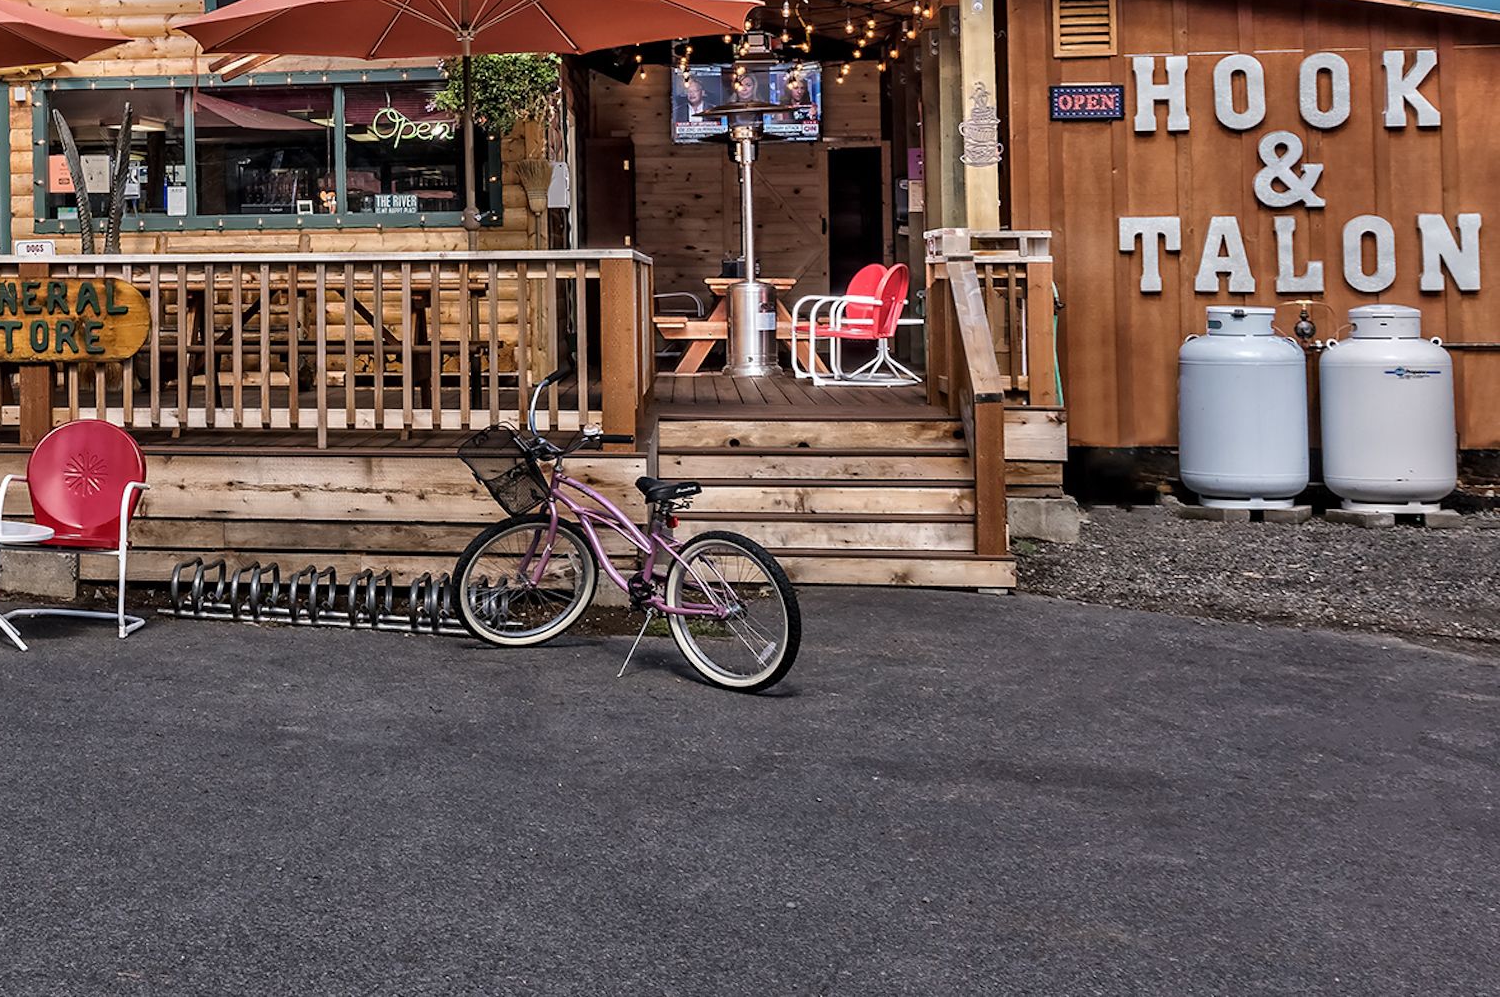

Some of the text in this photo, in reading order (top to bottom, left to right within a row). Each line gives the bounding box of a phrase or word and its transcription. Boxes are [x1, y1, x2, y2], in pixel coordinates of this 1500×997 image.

[1058, 93, 1116, 111] OPEN
[1131, 48, 1442, 133] HOOK
[373, 107, 455, 149] Open
[1252, 130, 1326, 209] &
[375, 194, 417, 207] THE RIVER
[26, 244, 44, 253] DOGS
[1117, 212, 1482, 294] TALON
